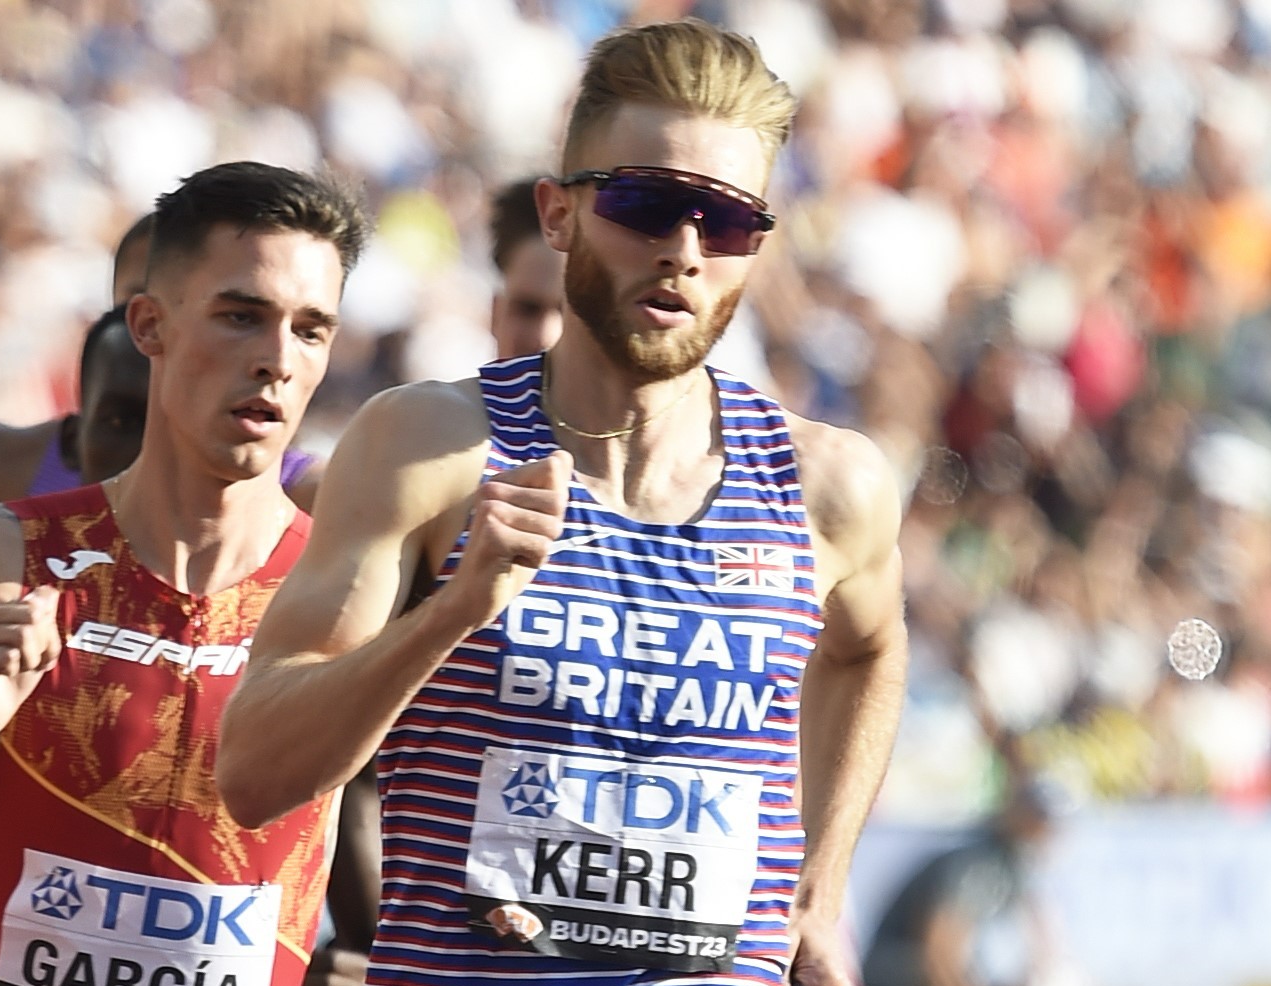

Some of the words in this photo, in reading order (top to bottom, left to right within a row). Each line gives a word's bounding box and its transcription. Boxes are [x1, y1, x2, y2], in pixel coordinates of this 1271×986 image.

[503, 596, 783, 673] GREAT
[499, 655, 776, 732] BRITAIN
[562, 766, 741, 837] TDK
[532, 837, 698, 912] KERR
[87, 877, 260, 946] TDK
[550, 918, 703, 957] BUDAPEST
[702, 936, 728, 957] 23
